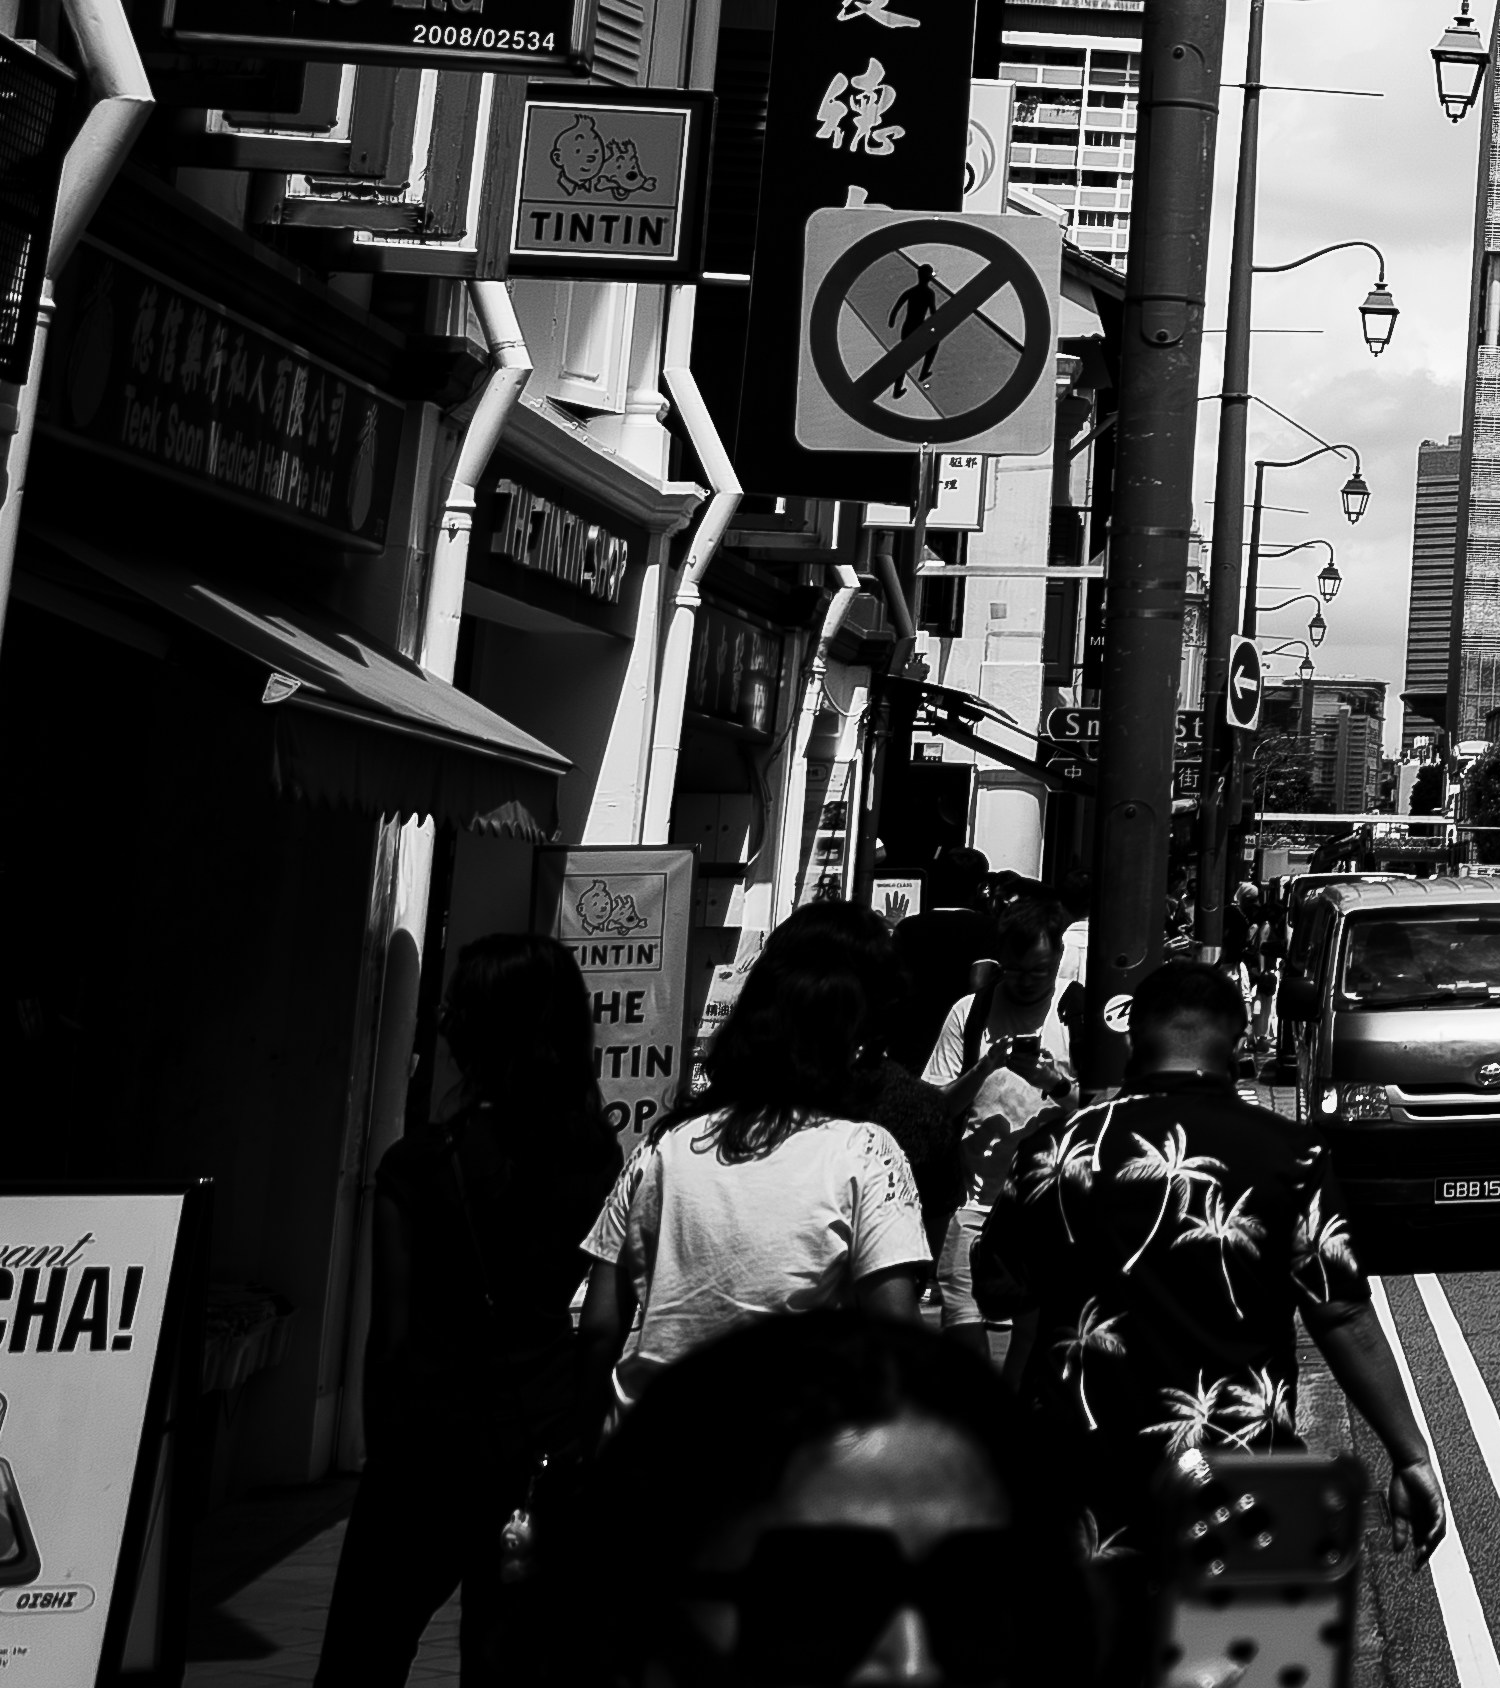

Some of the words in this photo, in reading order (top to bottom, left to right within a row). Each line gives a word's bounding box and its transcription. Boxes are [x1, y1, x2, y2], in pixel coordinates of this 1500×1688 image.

[412, 25, 557, 54] 2008/02534
[530, 211, 664, 247] TINTIN
[121, 383, 162, 453] Teck
[164, 400, 204, 470] Soon
[206, 420, 262, 491] Medical
[260, 443, 290, 501] Hall
[286, 455, 310, 510] Pte
[310, 464, 335, 518] Ltd
[593, 991, 645, 1024] HE
[602, 1099, 658, 1133] OP
